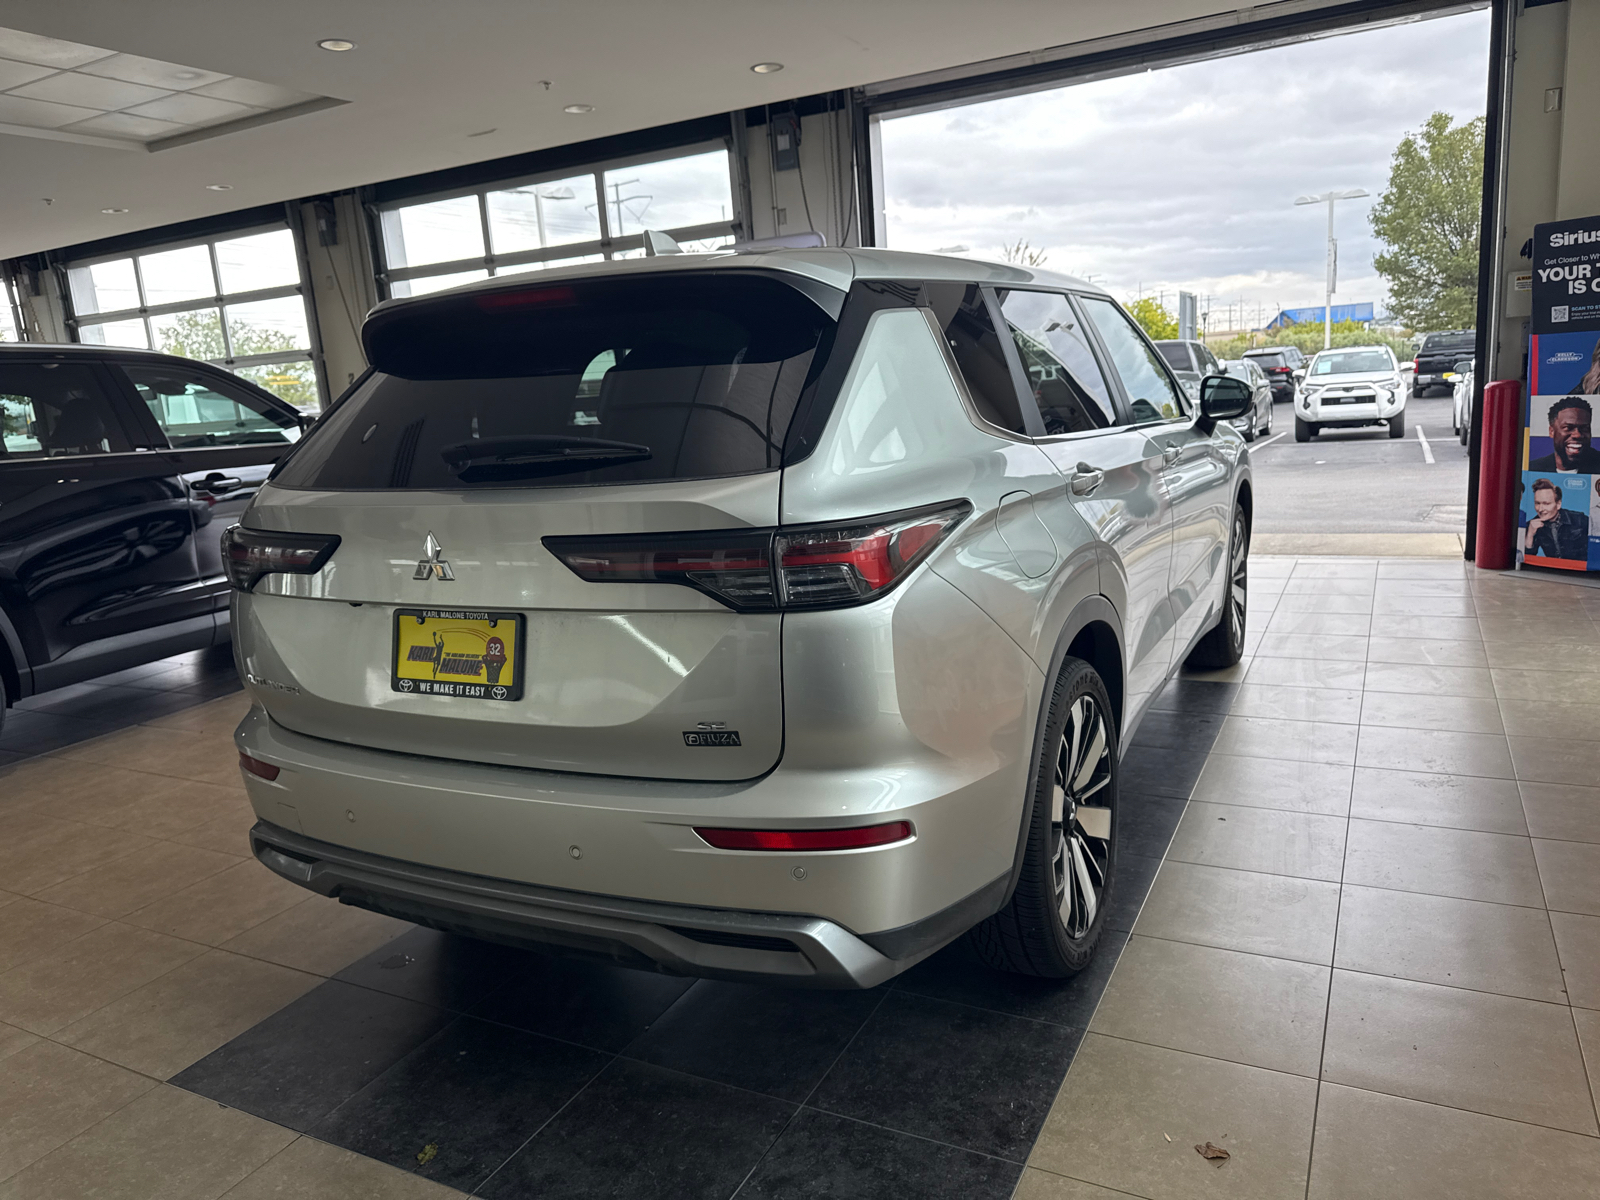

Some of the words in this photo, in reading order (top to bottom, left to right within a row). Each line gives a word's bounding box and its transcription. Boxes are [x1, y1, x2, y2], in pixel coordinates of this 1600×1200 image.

[1558, 256, 1580, 264] Closer
[1537, 264, 1592, 282] YOUR
[1568, 279, 1587, 295] IS
[422, 610, 440, 618] KARL
[440, 611, 465, 619] MALONE
[466, 612, 489, 620] TOYOTA
[407, 645, 436, 662] KARL
[489, 643, 501, 656] 32
[439, 657, 483, 676] MALONE
[419, 682, 431, 692] WE
[433, 683, 454, 694] MAKE
[456, 685, 463, 695] IT
[465, 685, 485, 696] EASY
